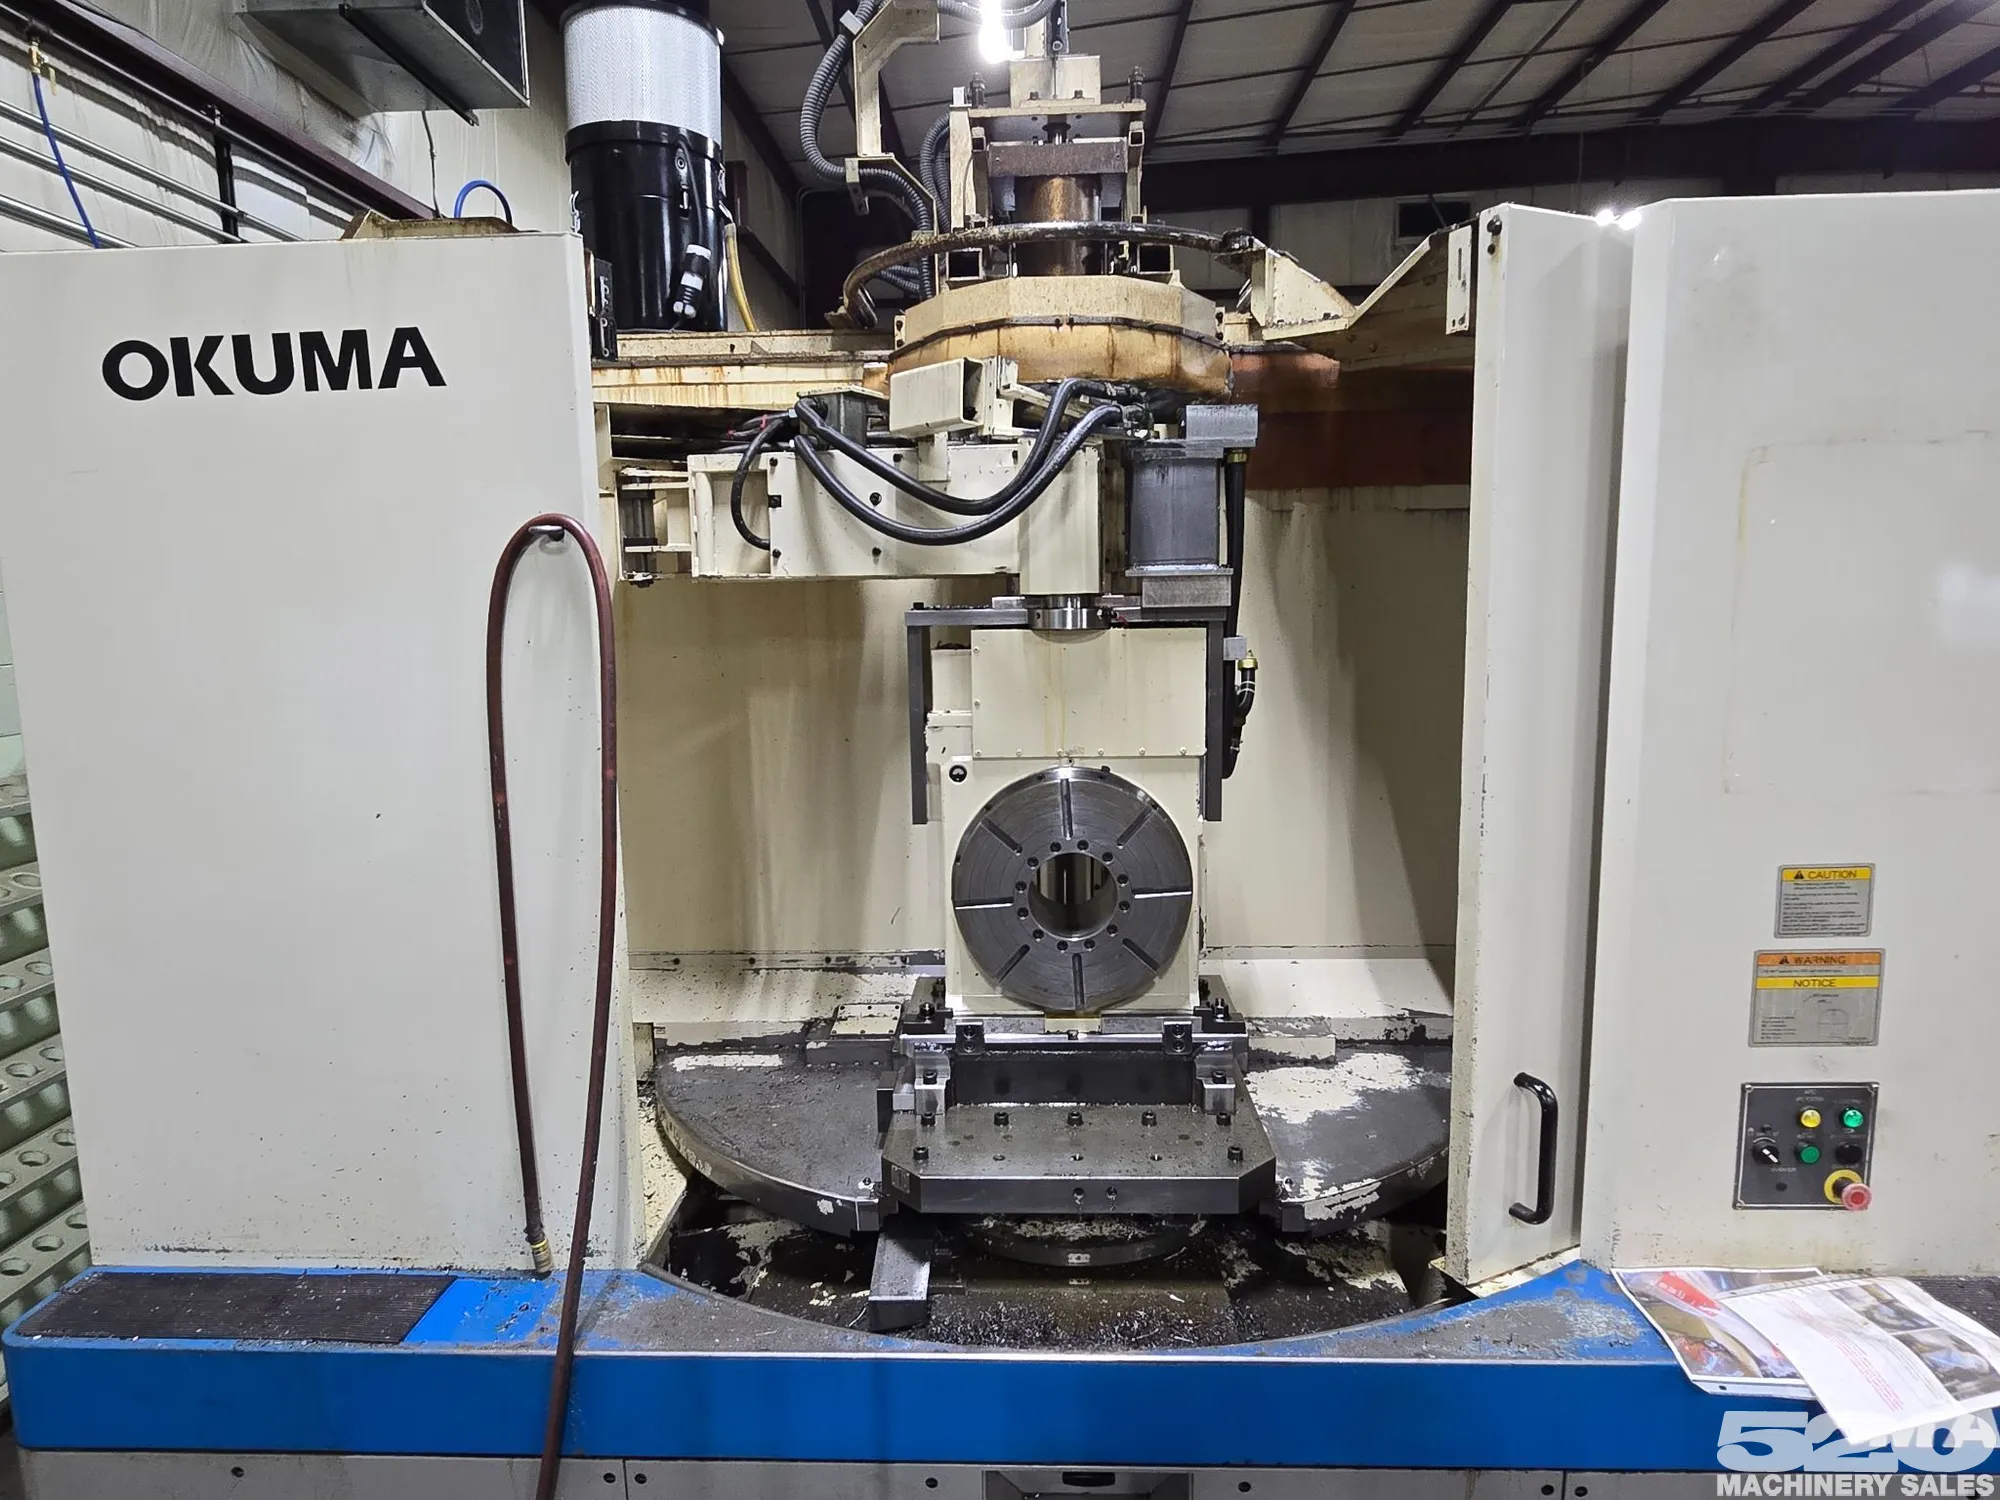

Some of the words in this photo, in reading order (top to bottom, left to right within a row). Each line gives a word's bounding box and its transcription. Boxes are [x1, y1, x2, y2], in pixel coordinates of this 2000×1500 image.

[101, 326, 447, 401] OKUMA
[1807, 870, 1857, 880] CAUTION
[1793, 955, 1846, 965] WARNING
[1793, 978, 1837, 988] NOTICE
